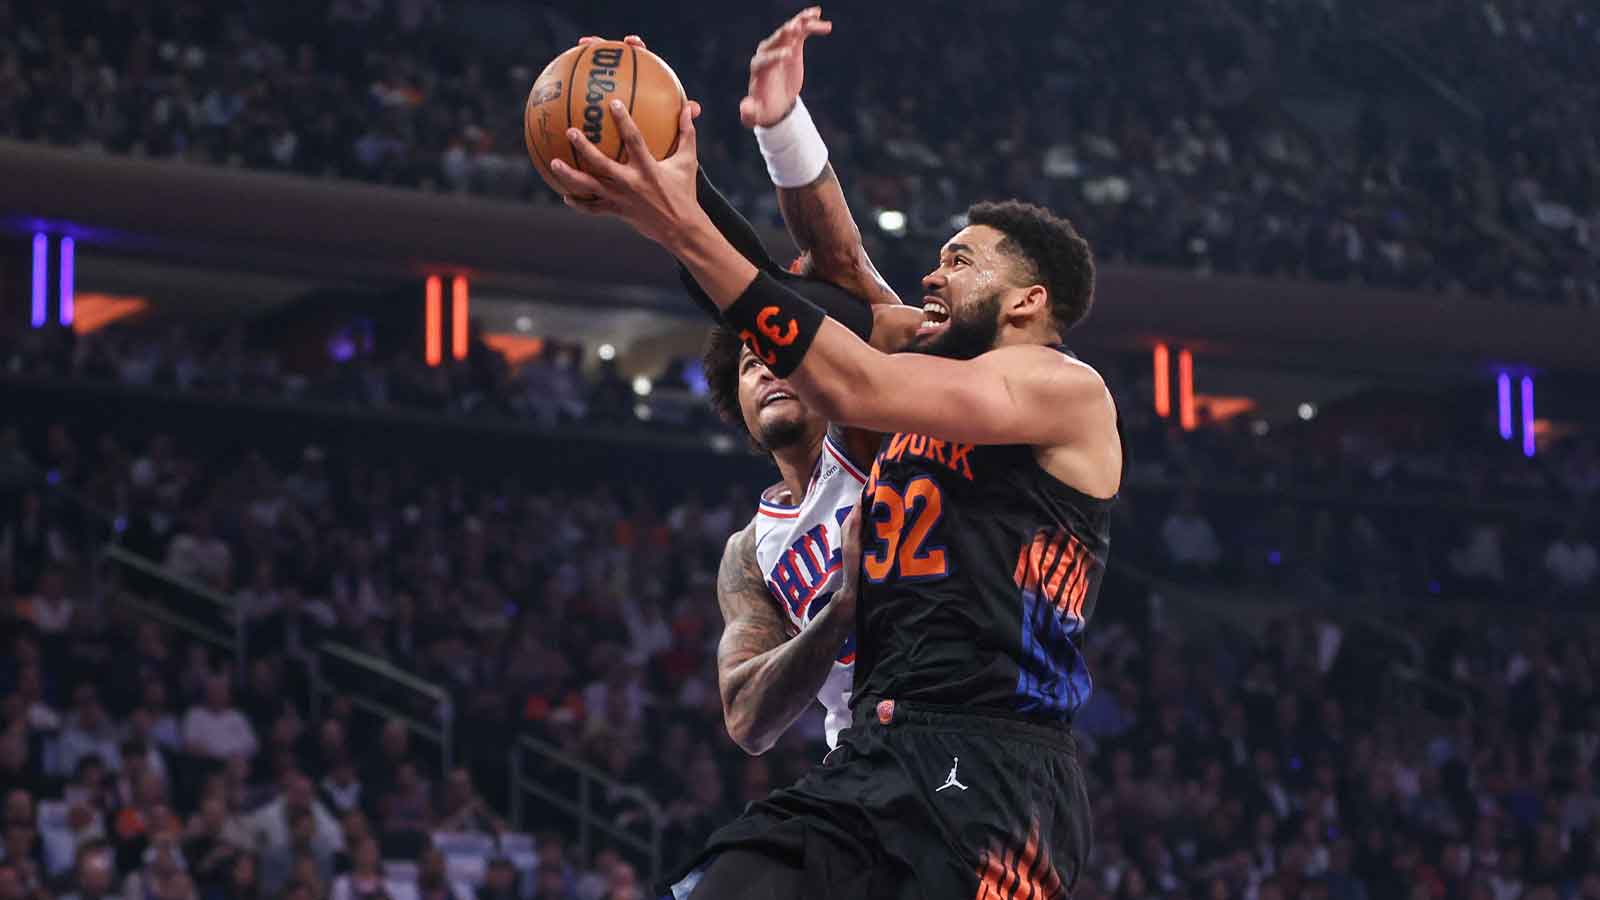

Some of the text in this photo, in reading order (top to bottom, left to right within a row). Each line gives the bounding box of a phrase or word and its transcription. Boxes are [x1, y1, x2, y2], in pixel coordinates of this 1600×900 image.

[584, 48, 623, 143] Wilson
[767, 505, 853, 617] HIL
[863, 475, 949, 583] 32
